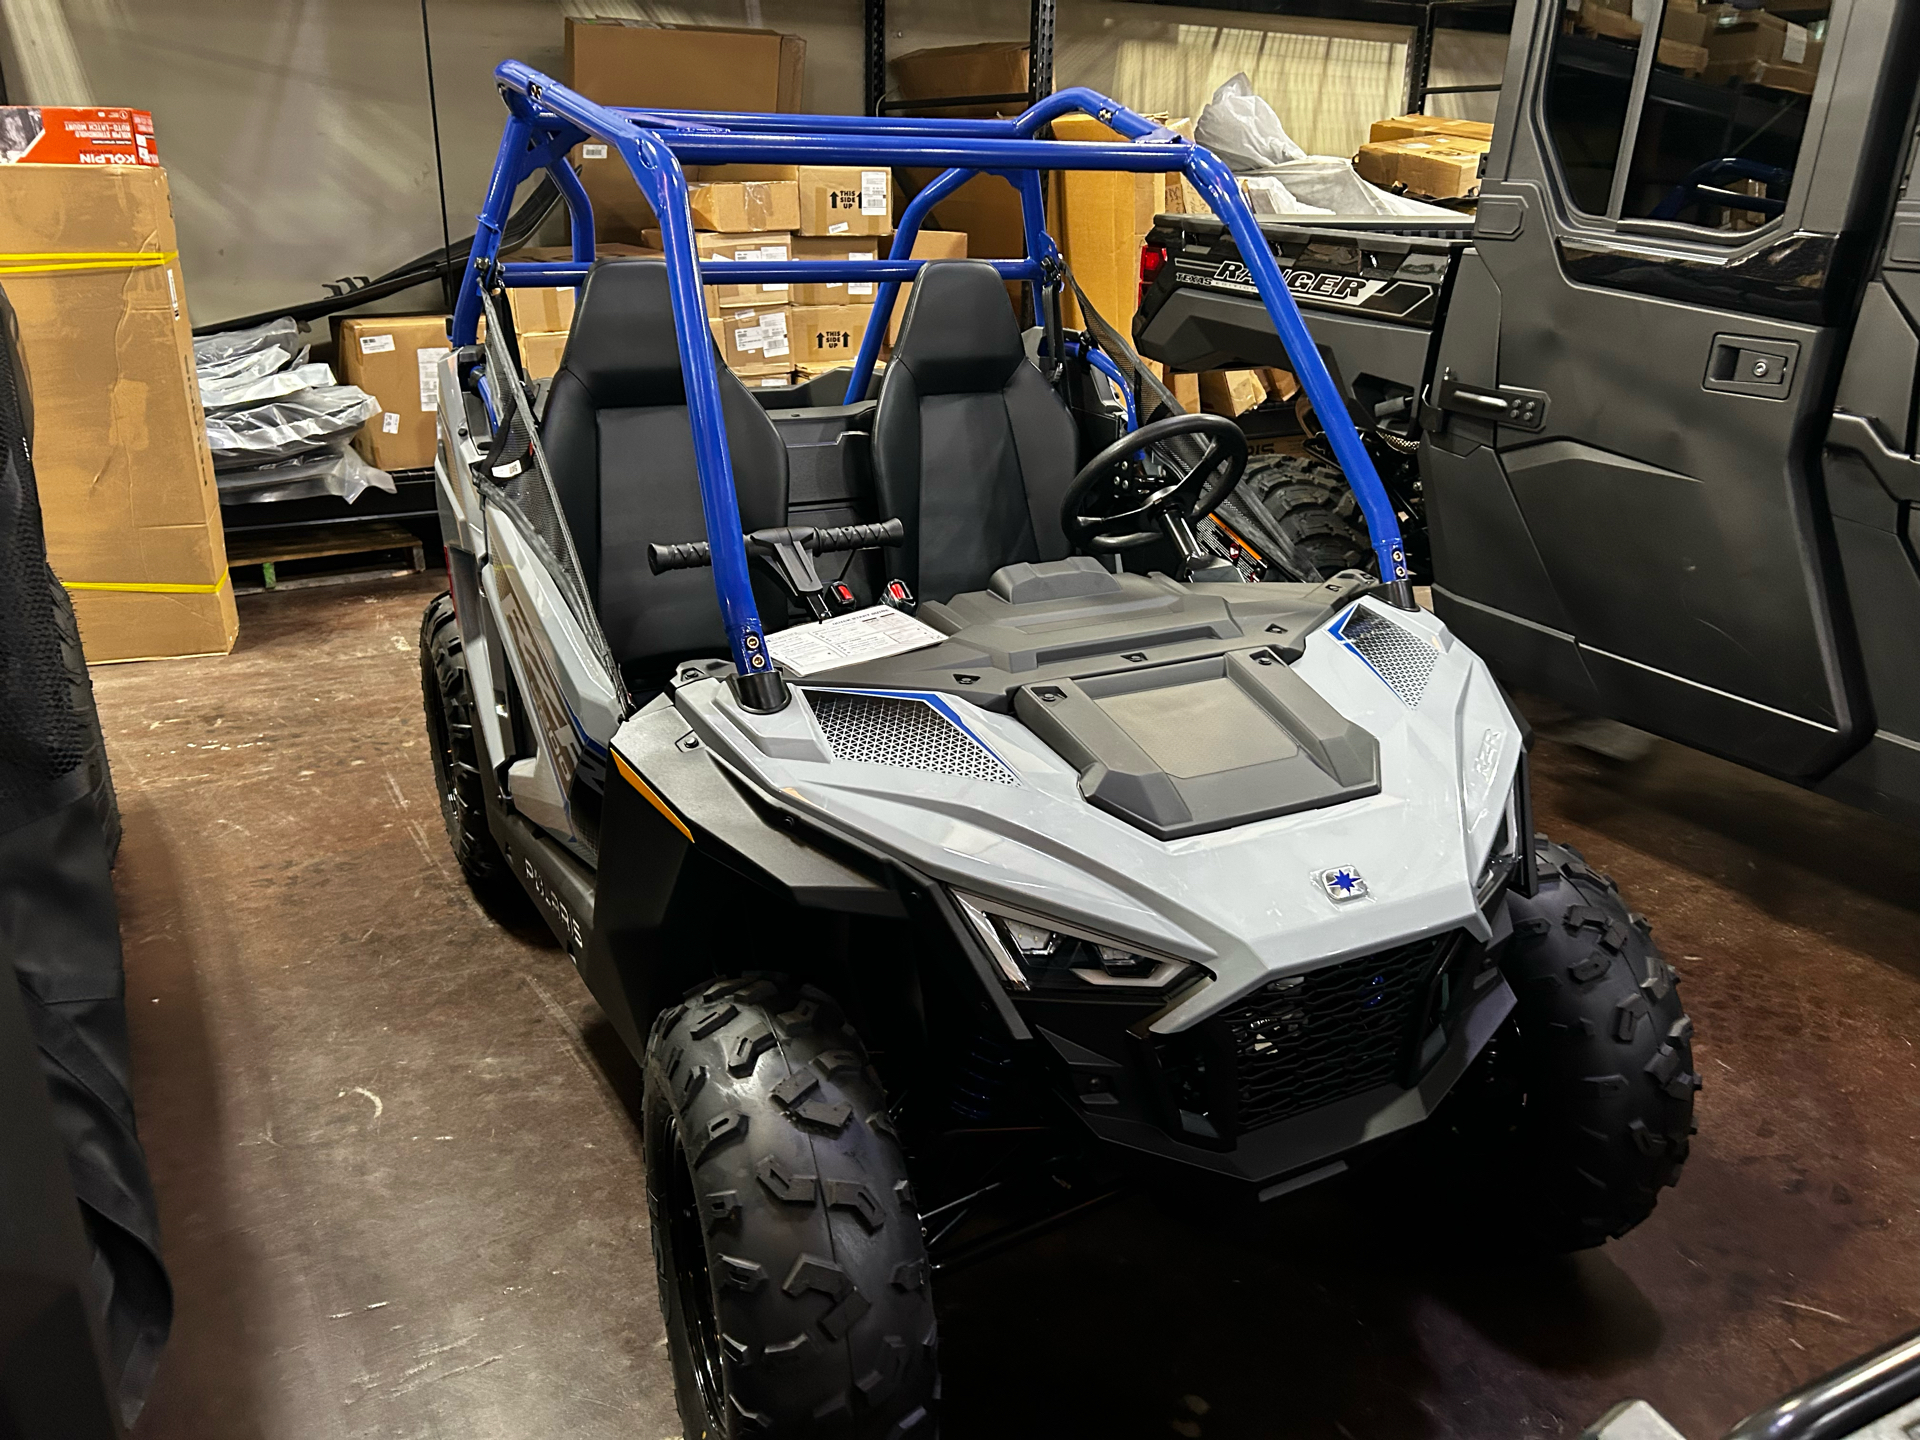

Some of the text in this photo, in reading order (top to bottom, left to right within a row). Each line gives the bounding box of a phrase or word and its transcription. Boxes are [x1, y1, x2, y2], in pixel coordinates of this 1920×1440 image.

[79, 153, 136, 164] KOLPIN
[1176, 272, 1214, 286] TEXAS
[524, 857, 583, 949] POLARIS
